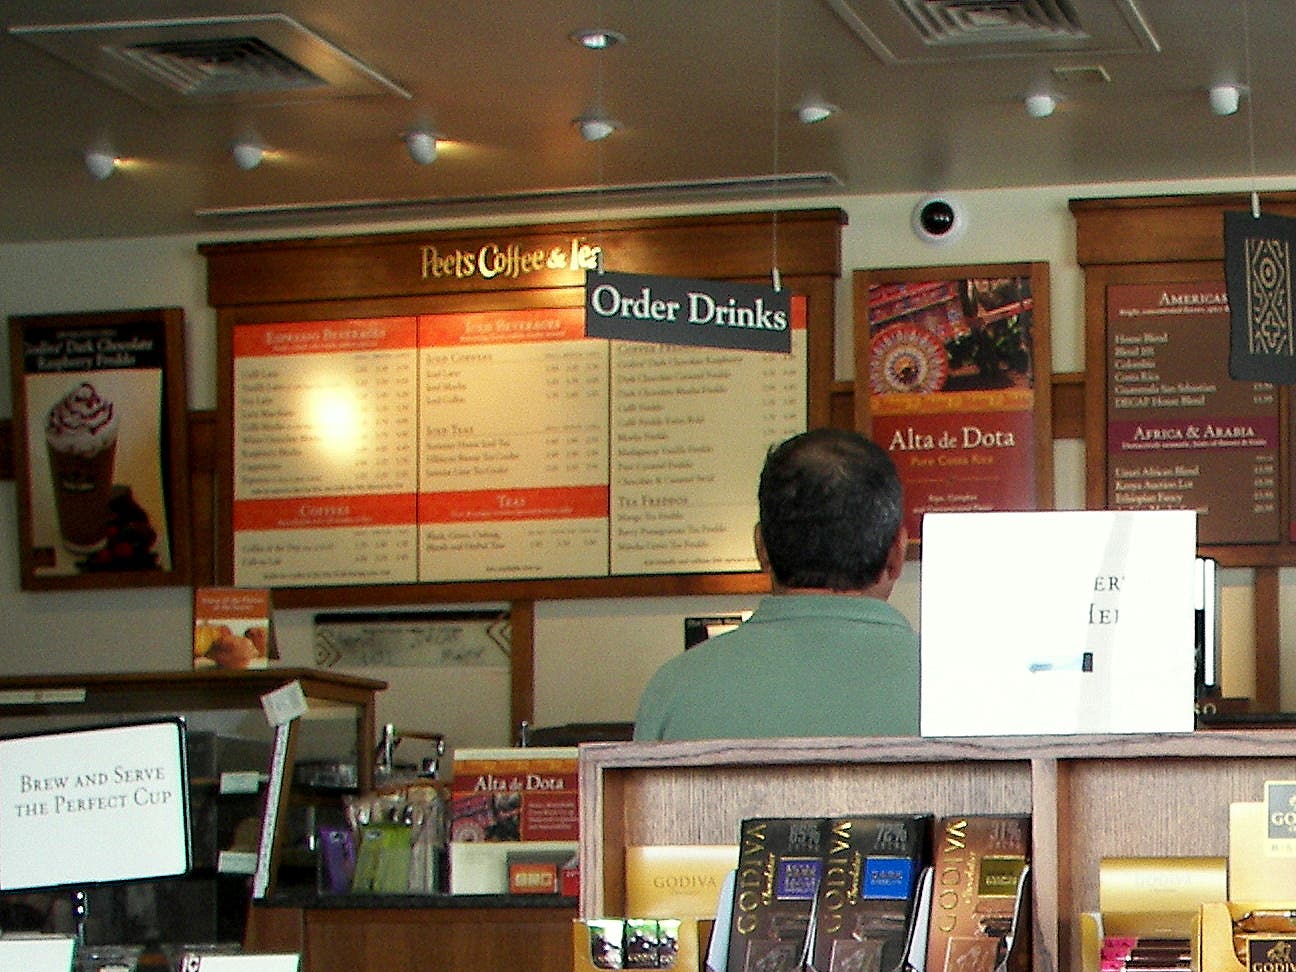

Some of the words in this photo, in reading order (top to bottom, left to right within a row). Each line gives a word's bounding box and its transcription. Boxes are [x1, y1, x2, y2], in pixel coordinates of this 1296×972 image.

[478, 242, 545, 279] Coffee
[591, 284, 681, 321] Order
[687, 291, 789, 331] Drinks
[889, 427, 935, 451] Alta
[938, 430, 957, 449] de
[962, 426, 1016, 449] Dota
[1134, 425, 1183, 441] AFRICA
[1185, 425, 1200, 439] &
[20, 774, 69, 793] BREW
[74, 773, 109, 788] AND
[114, 766, 165, 785] SERVE
[474, 774, 507, 792] Alta
[526, 774, 565, 791] Dota
[14, 801, 49, 818] THE
[54, 794, 128, 816] PERFECT
[134, 786, 172, 807] CUP
[653, 876, 717, 890] GODIVA
[737, 823, 767, 935] GODIVA
